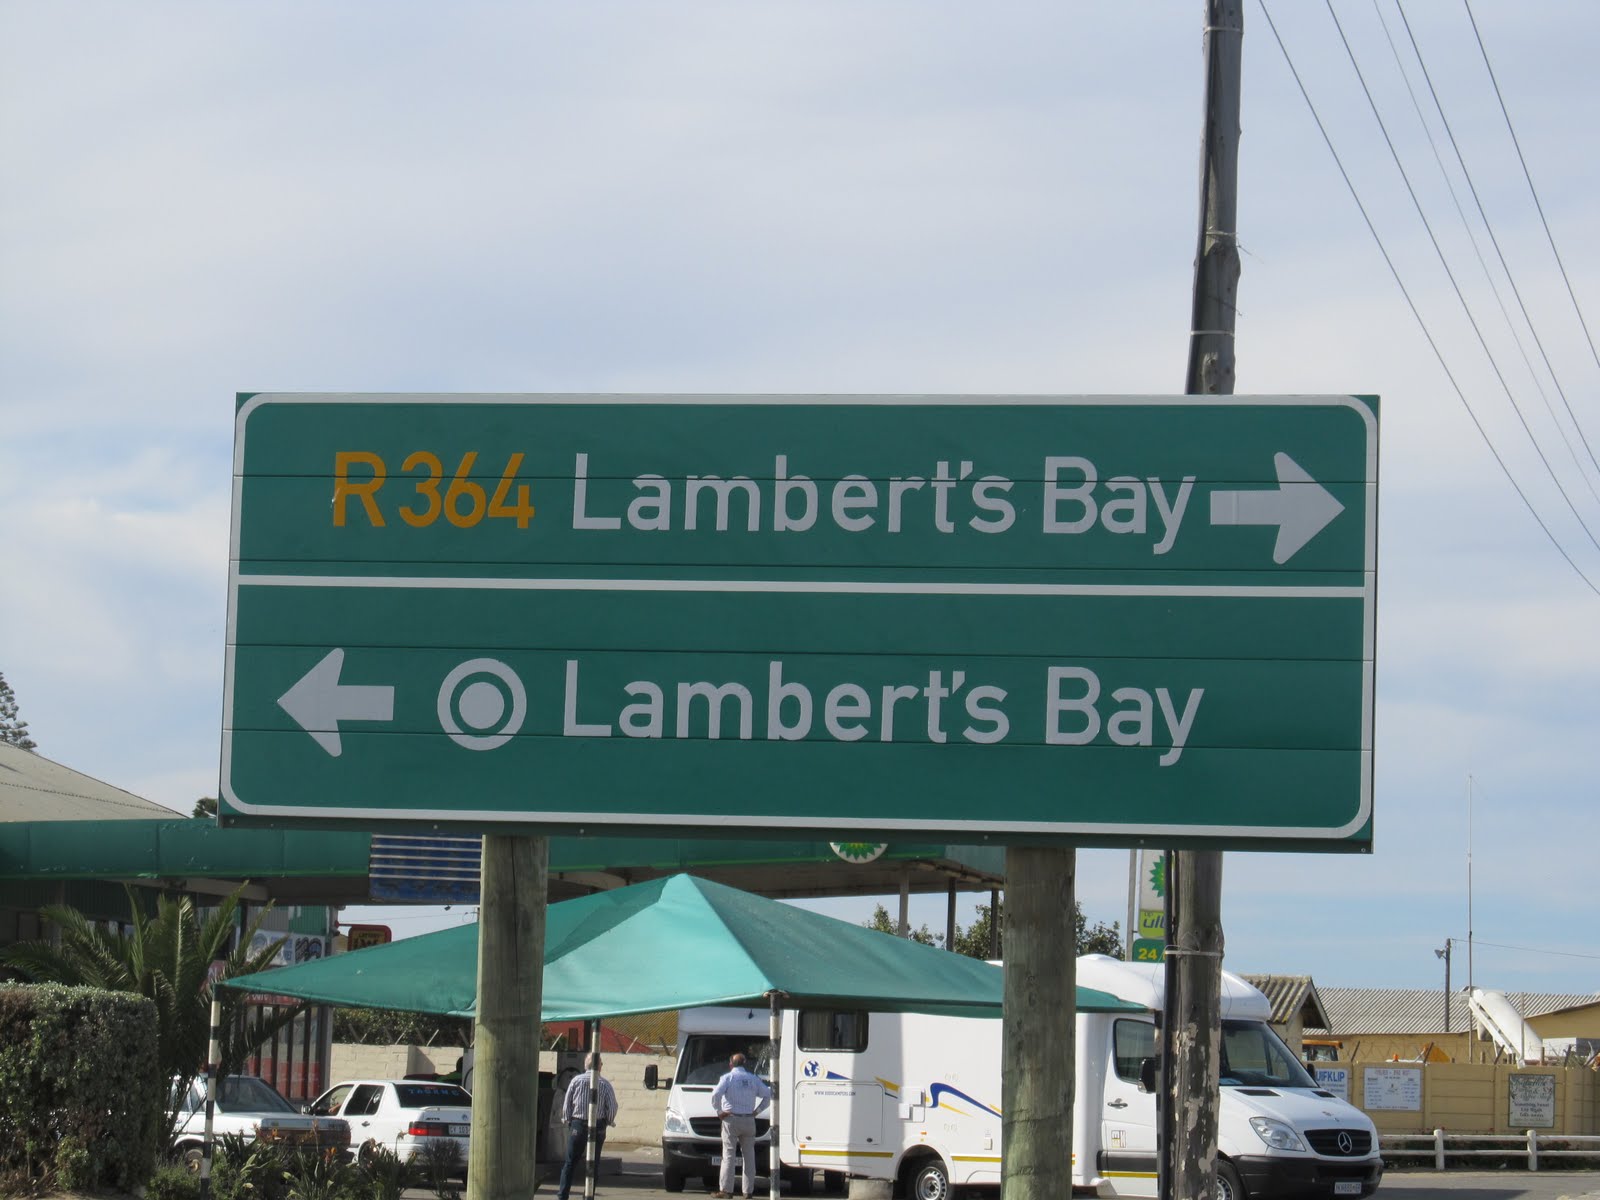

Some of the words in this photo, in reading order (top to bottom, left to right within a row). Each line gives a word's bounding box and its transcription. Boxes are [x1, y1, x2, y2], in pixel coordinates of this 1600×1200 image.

[572, 453, 1016, 534] Lambert's
[1043, 456, 1196, 555] Bay
[563, 660, 1010, 744] Lambert's
[1045, 666, 1205, 766] Bay
[1138, 948, 1157, 960] 24
